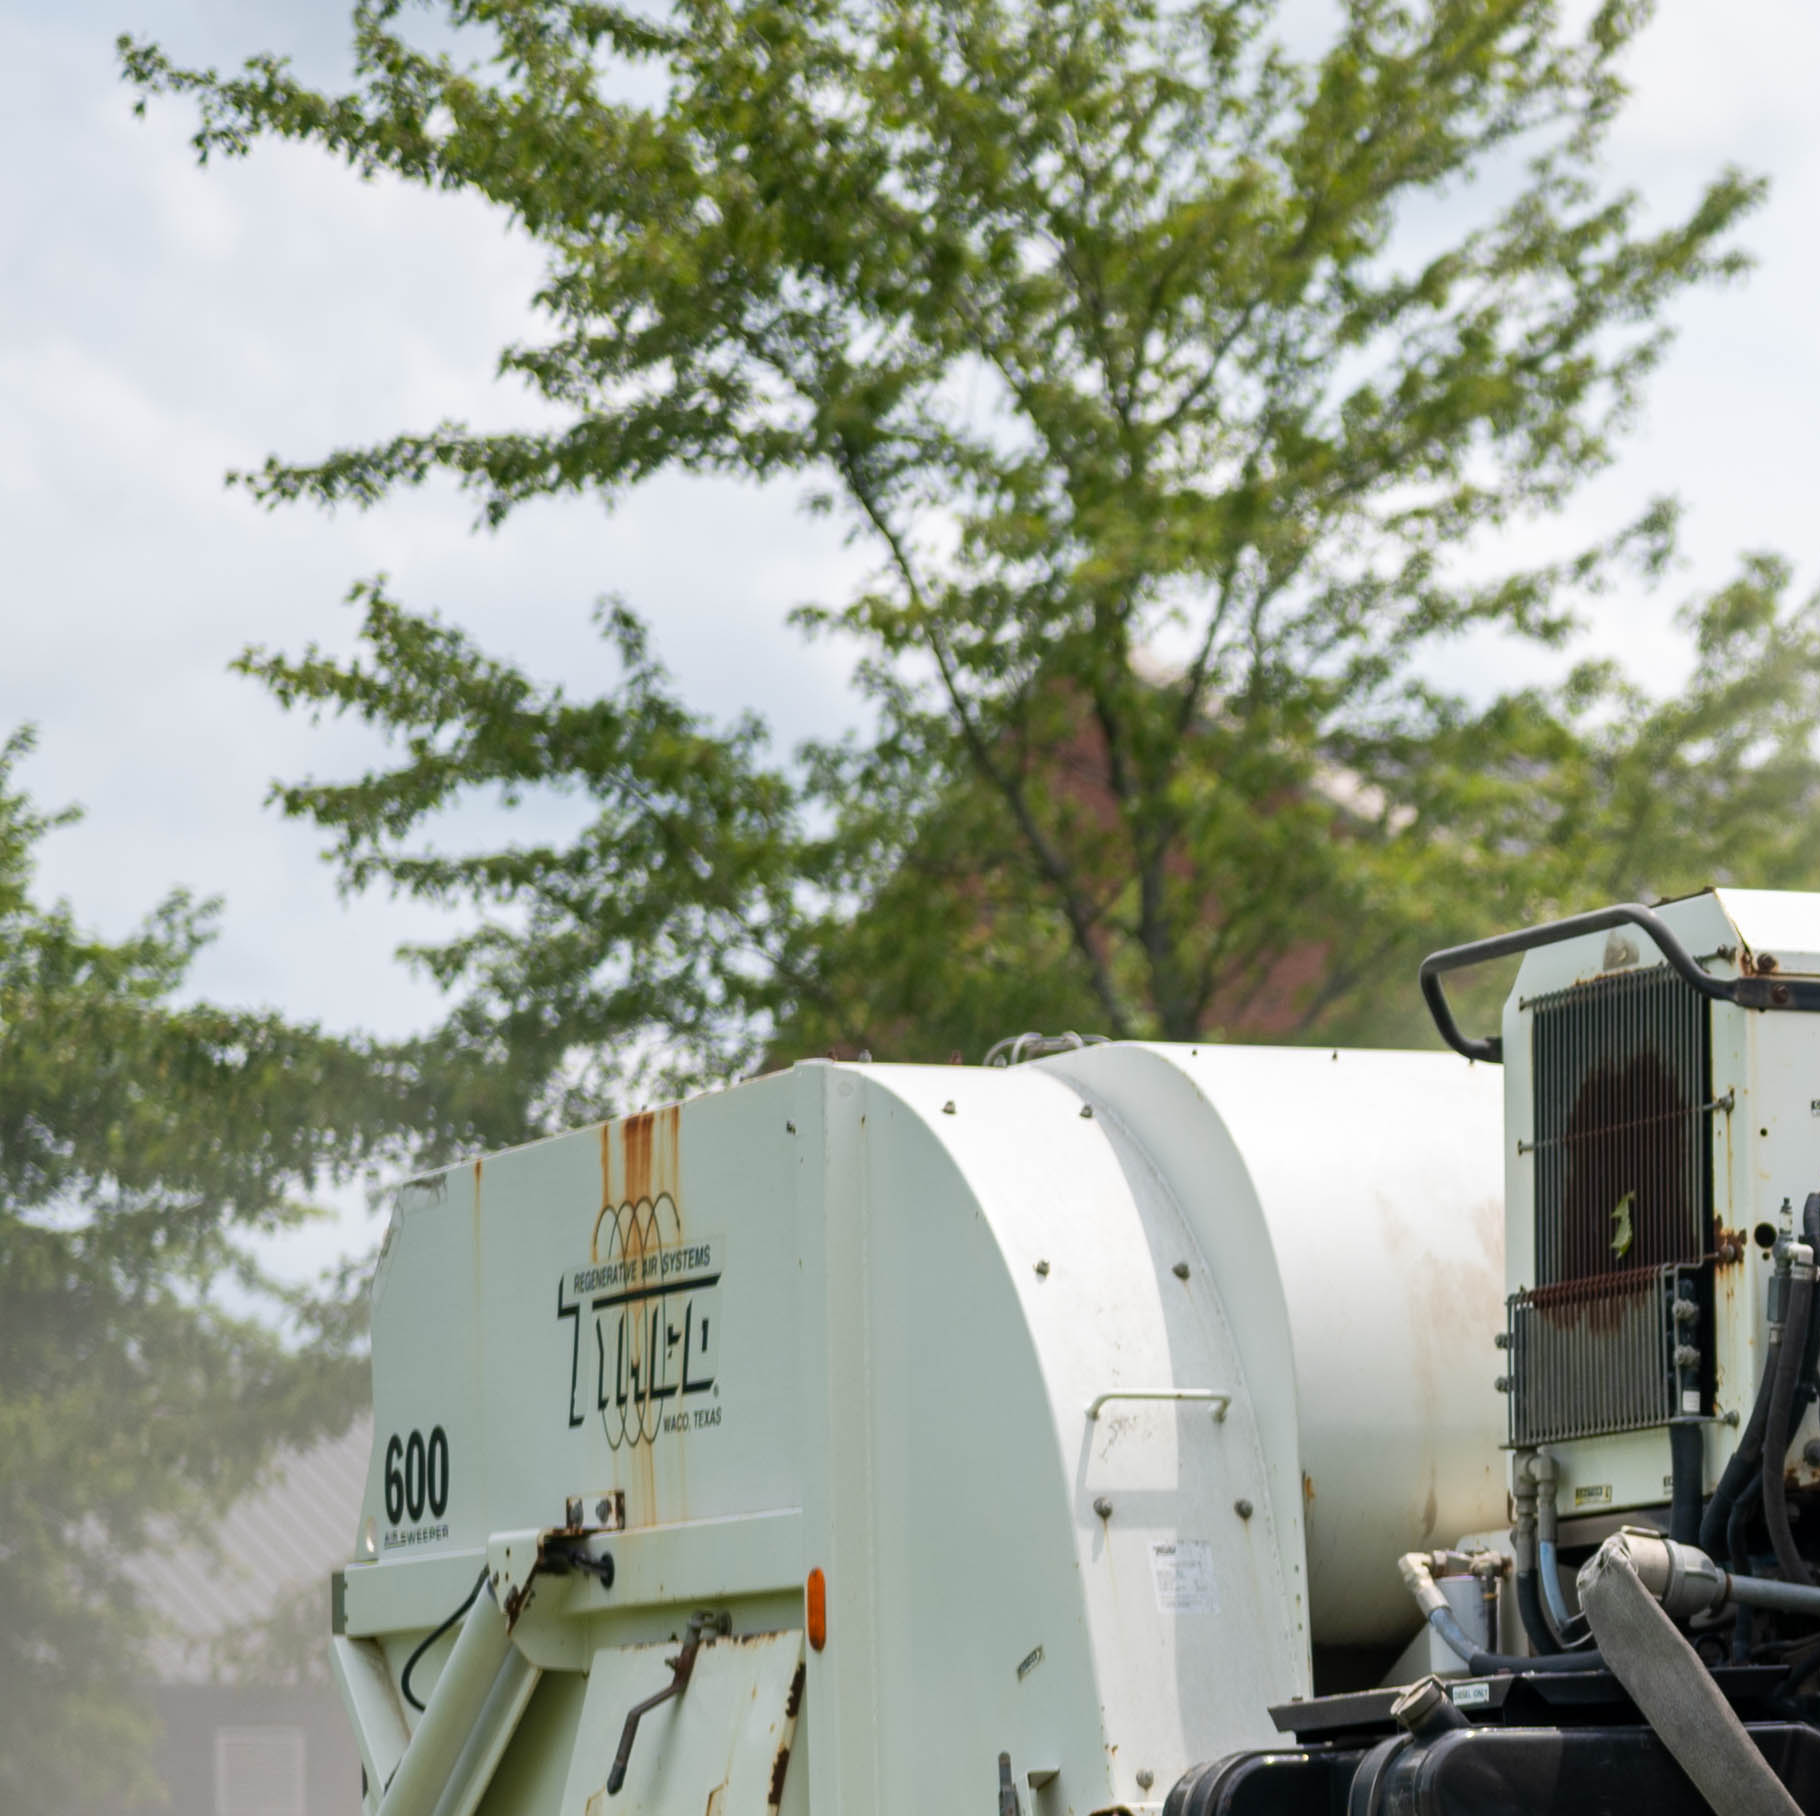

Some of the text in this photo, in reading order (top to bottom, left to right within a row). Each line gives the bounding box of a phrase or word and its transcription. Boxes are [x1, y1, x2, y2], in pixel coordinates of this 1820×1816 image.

[574, 1244, 711, 1293] REGENERATIVE AIR SYSTEMS
[557, 1270, 722, 1429] TYMCO
[663, 1406, 722, 1434] WACO, TEXAS
[384, 1424, 449, 1526] 600
